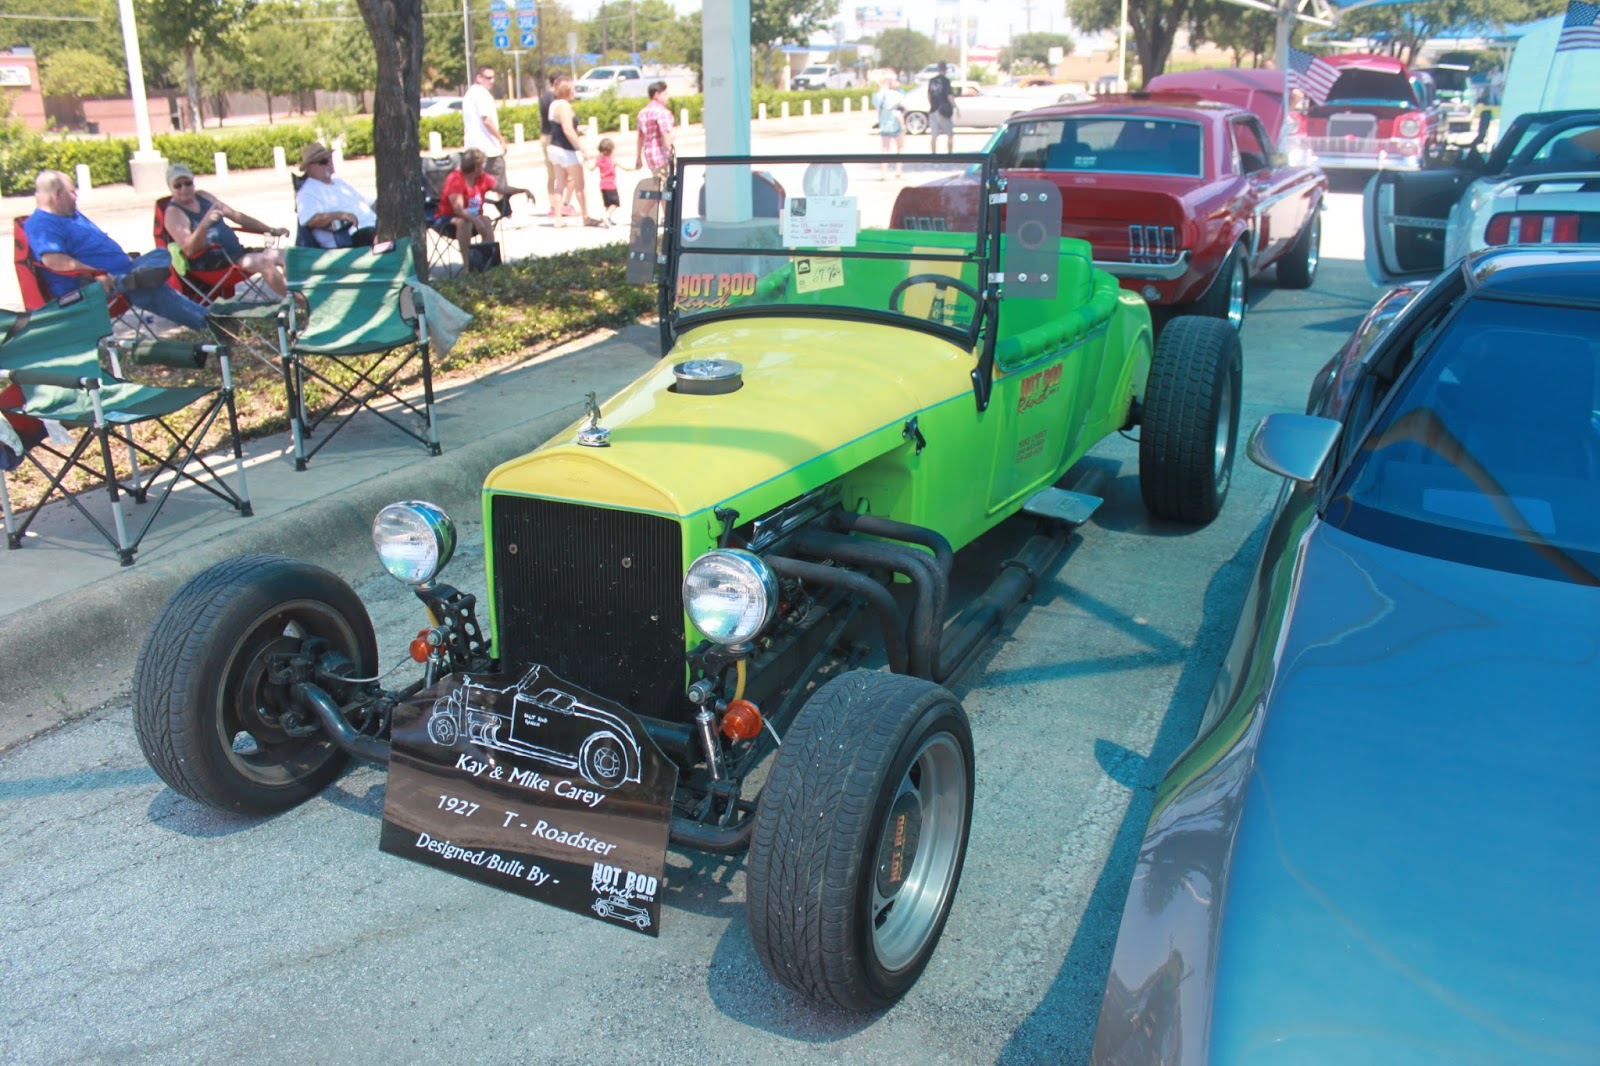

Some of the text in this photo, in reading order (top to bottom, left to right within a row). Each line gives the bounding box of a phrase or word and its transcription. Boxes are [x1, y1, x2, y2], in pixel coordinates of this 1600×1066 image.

[677, 272, 757, 297] HOT ROD
[673, 292, 733, 313] Ranch
[1020, 363, 1063, 398] HOT ROD
[455, 753, 606, 808] Kay & Mike Carey
[437, 795, 480, 817] 1927
[502, 811, 519, 828] T
[531, 820, 617, 856] Roadster
[894, 814, 905, 848] ROD
[415, 832, 525, 878] Designed/Built
[526, 865, 551, 886] By
[889, 851, 901, 883] HOT
[591, 862, 658, 896] HOT ROD
[591, 874, 635, 900] Ranch
